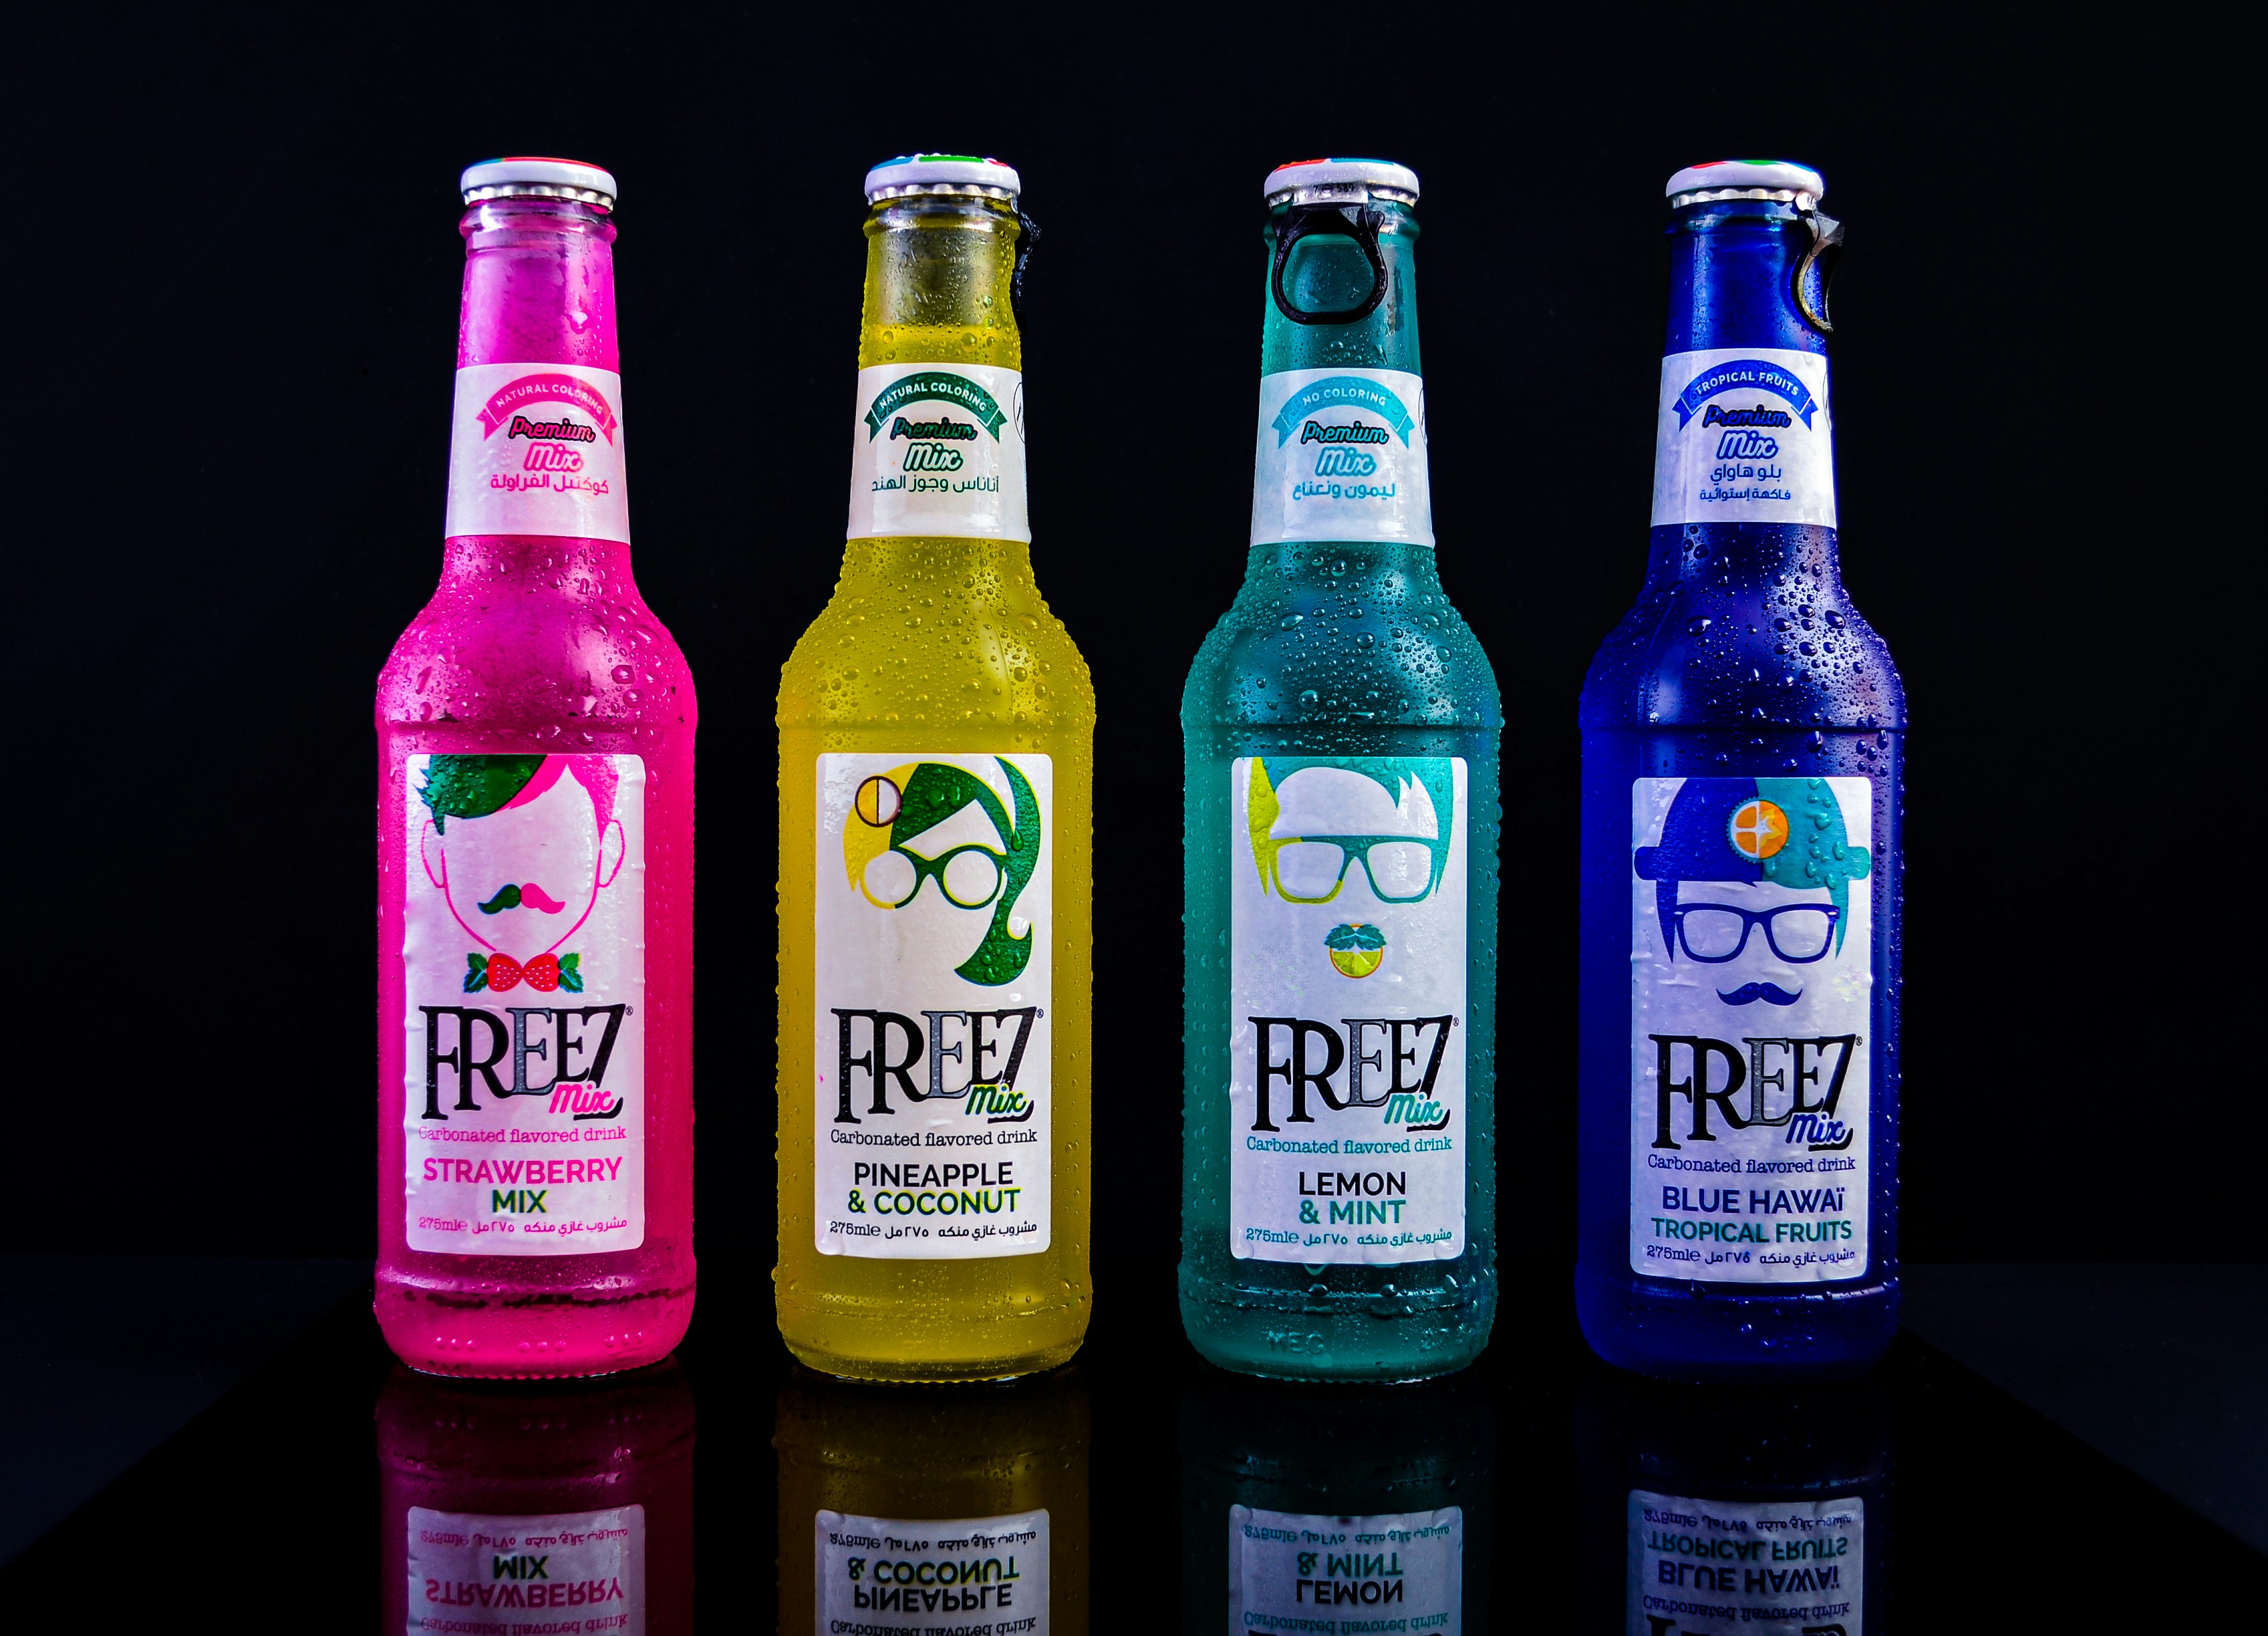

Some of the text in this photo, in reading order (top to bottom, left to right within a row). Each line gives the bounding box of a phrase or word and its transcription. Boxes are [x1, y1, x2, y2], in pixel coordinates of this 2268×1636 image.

[1695, 371, 1799, 396] TROPICAL FRUITS
[496, 384, 603, 414] NATURAL COLORING
[879, 382, 987, 412] NATURAL COLORING
[1302, 388, 1386, 406] NO COLORING
[1702, 404, 1792, 428] Premium
[508, 416, 596, 442] Premium
[890, 417, 978, 440] Premium
[1300, 420, 1389, 444] Premium
[523, 442, 583, 472] Mix
[903, 442, 963, 472] Mix
[1716, 430, 1778, 460] Mix
[1315, 446, 1377, 476] Mix
[490, 472, 549, 492] الفراولة
[871, 475, 906, 491] الهند
[909, 474, 949, 492] وجوز
[1711, 464, 1782, 485] بلو هاواي
[1293, 481, 1395, 500] ليمون ونعناع
[1752, 488, 1791, 501] فاكهة
[549, 1084, 615, 1113] Mix
[965, 1083, 1028, 1115] Mix
[1383, 1093, 1443, 1124] Mix
[418, 1126, 626, 1142] Carbonated flavored drink
[831, 1129, 1038, 1146] Carbonated flavored drink
[1786, 1113, 1846, 1143] Mix
[1246, 1136, 1452, 1154] Carbonated flavored drink
[423, 1156, 622, 1184] STRAWBERRY
[855, 1162, 1012, 1187] PINEAPPLE
[1648, 1154, 1856, 1174] Carbonated flavored drink
[1299, 1172, 1405, 1196] LEMON
[492, 1190, 547, 1213] MIX
[848, 1188, 1021, 1215] & COCONUT
[1299, 1200, 1406, 1224] & MINT
[1662, 1186, 1740, 1214] BLUE
[558, 1220, 583, 1237] غازي
[587, 1216, 627, 1230] مشروب
[972, 1224, 996, 1241] غازي
[998, 1221, 1037, 1236] مشروب
[1651, 1217, 1852, 1242] TROPICAL FRUITS
[1390, 1232, 1414, 1247] غازي
[1416, 1228, 1452, 1244] مشروب
